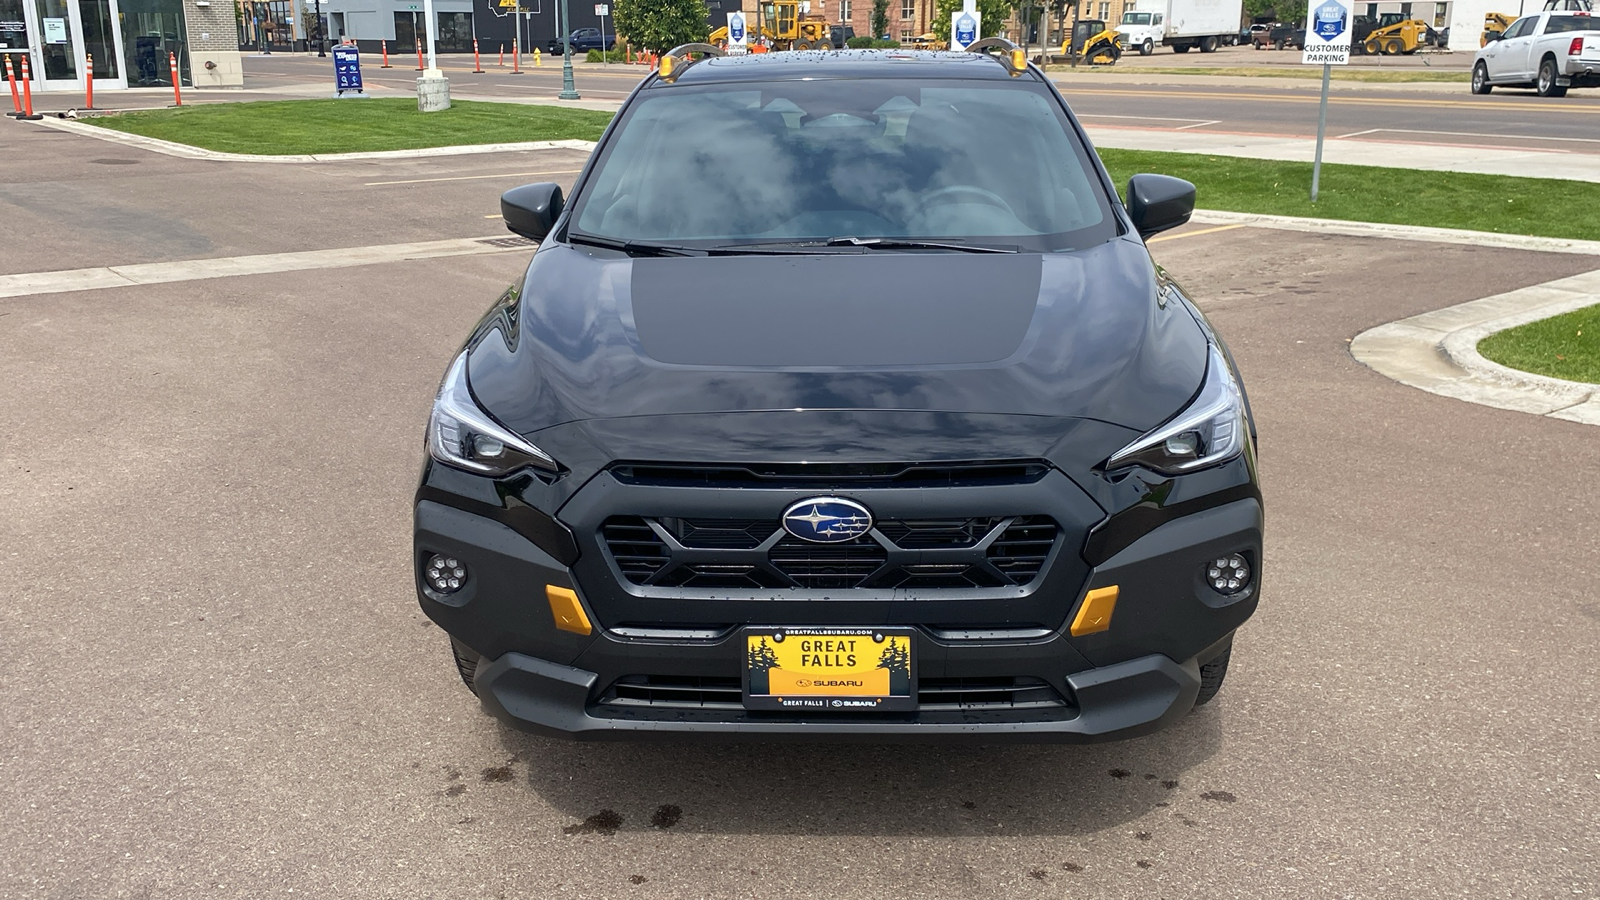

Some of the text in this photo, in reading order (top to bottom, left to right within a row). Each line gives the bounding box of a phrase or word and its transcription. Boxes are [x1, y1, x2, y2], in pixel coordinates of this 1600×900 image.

[1304, 44, 1350, 53] CUSTOMER
[1306, 54, 1345, 62] PARKING
[801, 640, 857, 652] GREAT
[802, 654, 857, 667] FALLS
